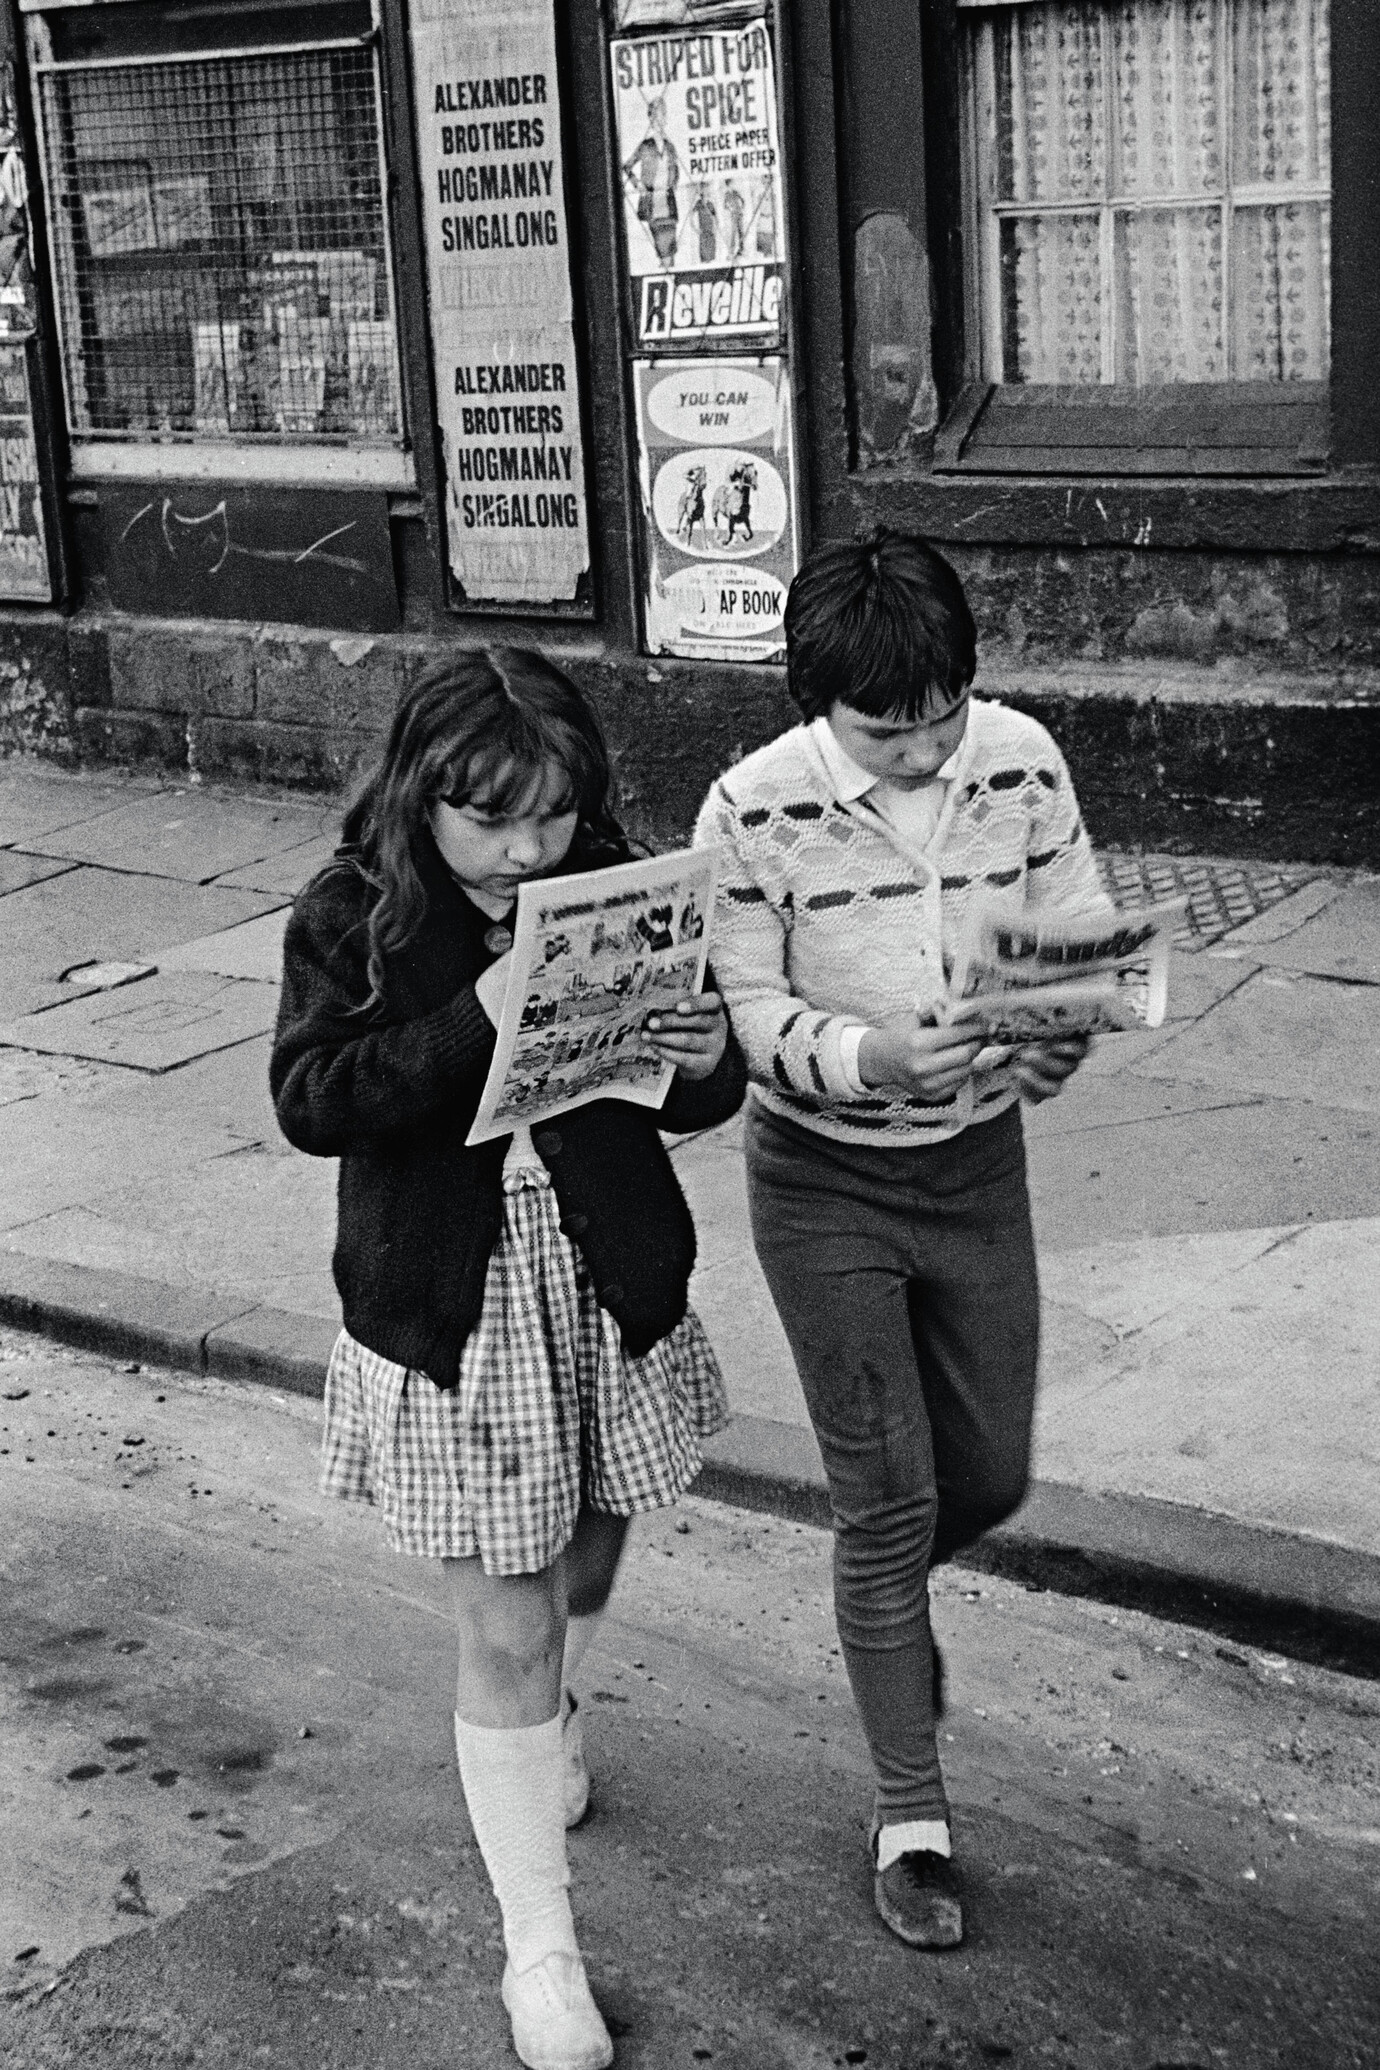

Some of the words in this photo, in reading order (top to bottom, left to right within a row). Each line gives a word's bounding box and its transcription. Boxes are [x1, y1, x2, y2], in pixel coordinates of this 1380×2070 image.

[616, 36, 714, 90] STRIPED
[722, 27, 768, 76] FOR
[435, 75, 547, 112] ALEXANDER
[685, 79, 757, 130] SPICE
[442, 118, 545, 154] BROTHERS
[689, 133, 732, 154] 5-PIECE
[736, 128, 769, 149] PAPER
[690, 152, 738, 174] PATTERN
[742, 148, 776, 169] OFFER
[438, 161, 553, 203] HOGMANAY
[442, 210, 558, 251] SINGALONG
[641, 267, 783, 338] Reveille
[455, 364, 566, 395] ALEXANDER
[679, 393, 709, 407] YOU
[715, 391, 748, 406] CAN
[462, 405, 564, 436] BROTHERS
[699, 413, 729, 427] WIN
[459, 445, 572, 481] HOGMANAY
[463, 494, 578, 529] SINGALONG
[743, 589, 782, 615] BOOK
